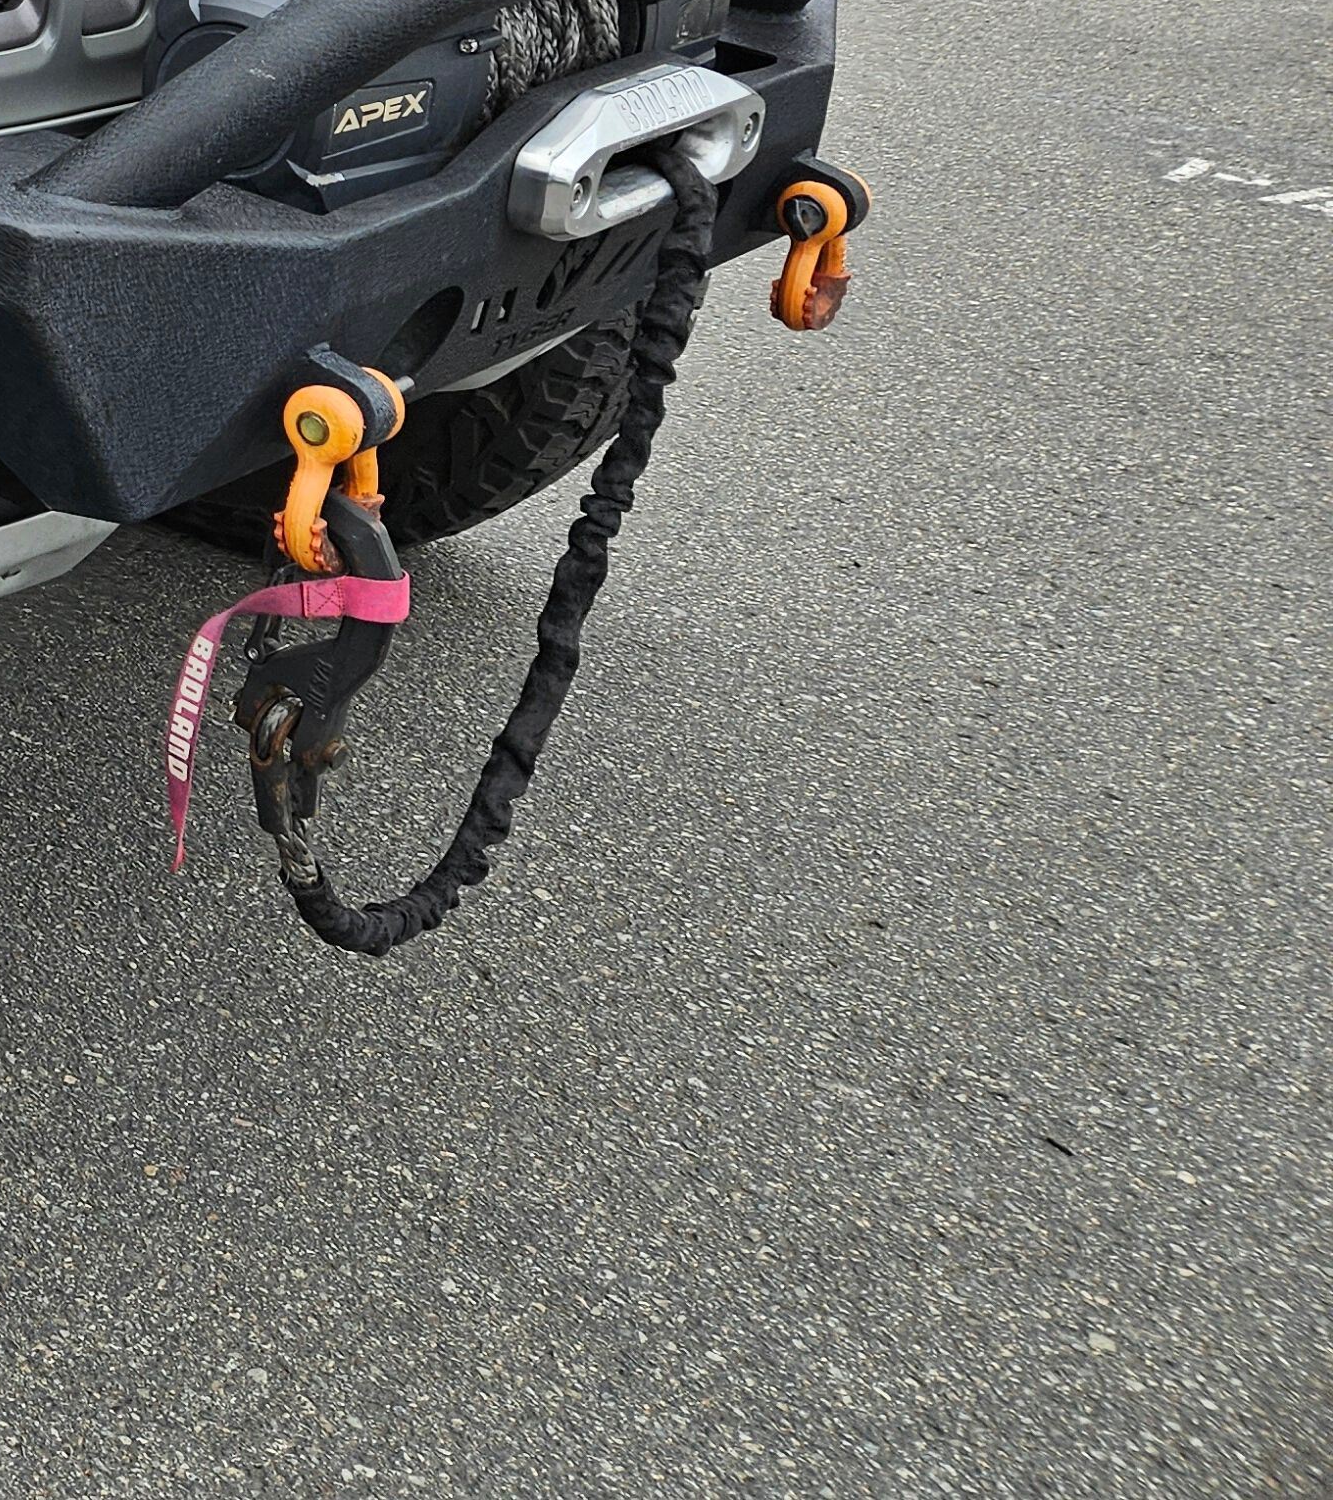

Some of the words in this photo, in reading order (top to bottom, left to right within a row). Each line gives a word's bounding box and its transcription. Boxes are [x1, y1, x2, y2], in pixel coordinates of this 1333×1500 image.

[334, 90, 428, 136] APEX
[611, 68, 714, 133] BADLAND
[168, 635, 214, 782] BADLAND
